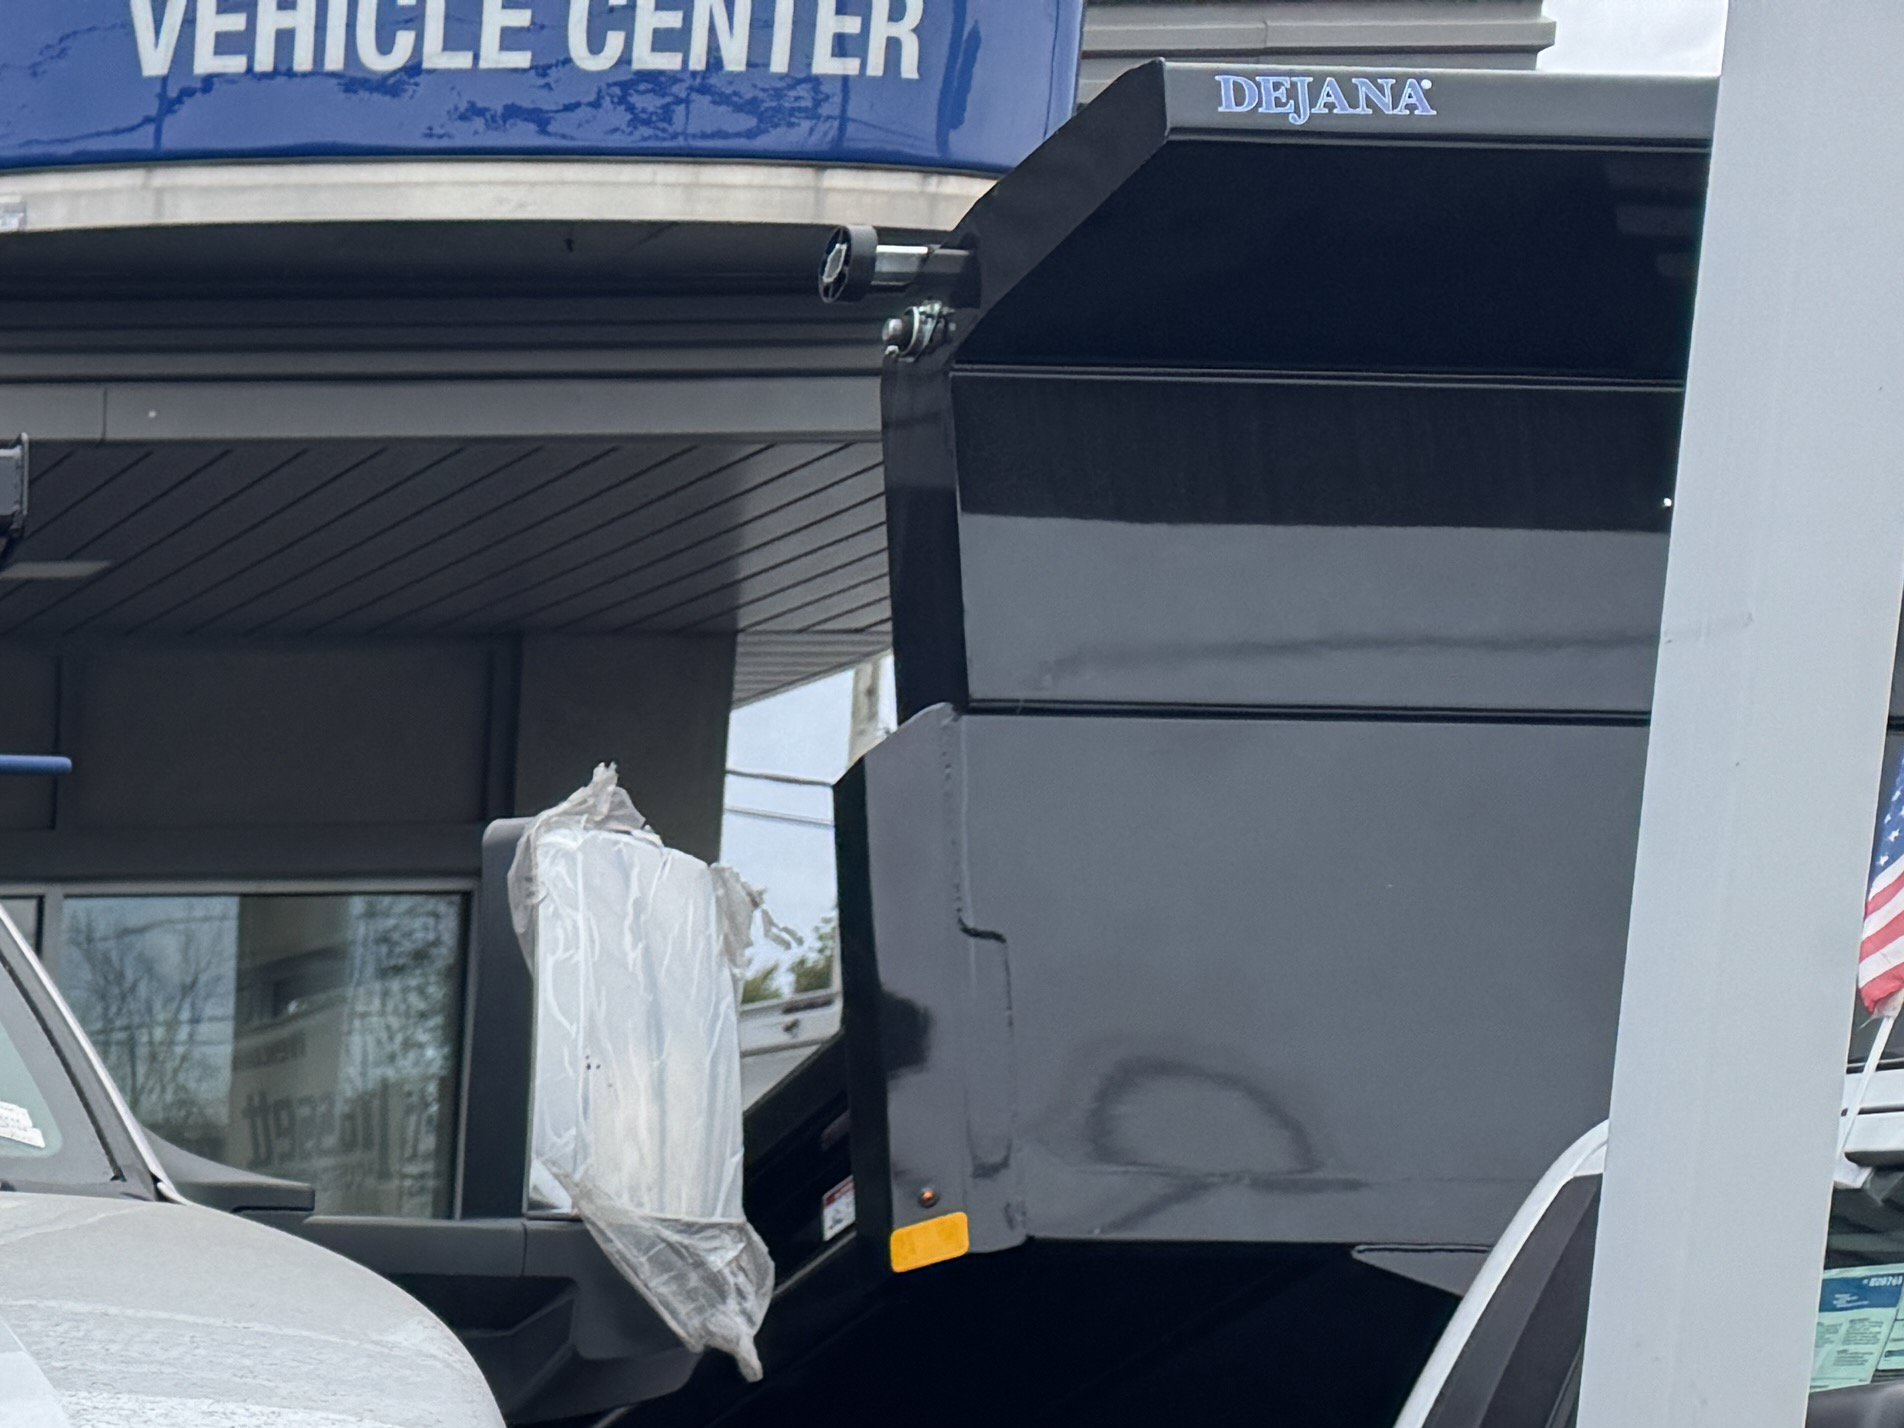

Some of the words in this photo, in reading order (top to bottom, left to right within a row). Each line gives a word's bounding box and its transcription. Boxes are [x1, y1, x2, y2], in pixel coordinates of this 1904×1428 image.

[131, 0, 534, 77] VEHICLE
[566, 0, 925, 79] CENTER
[1214, 75, 1437, 125] DEJANA
